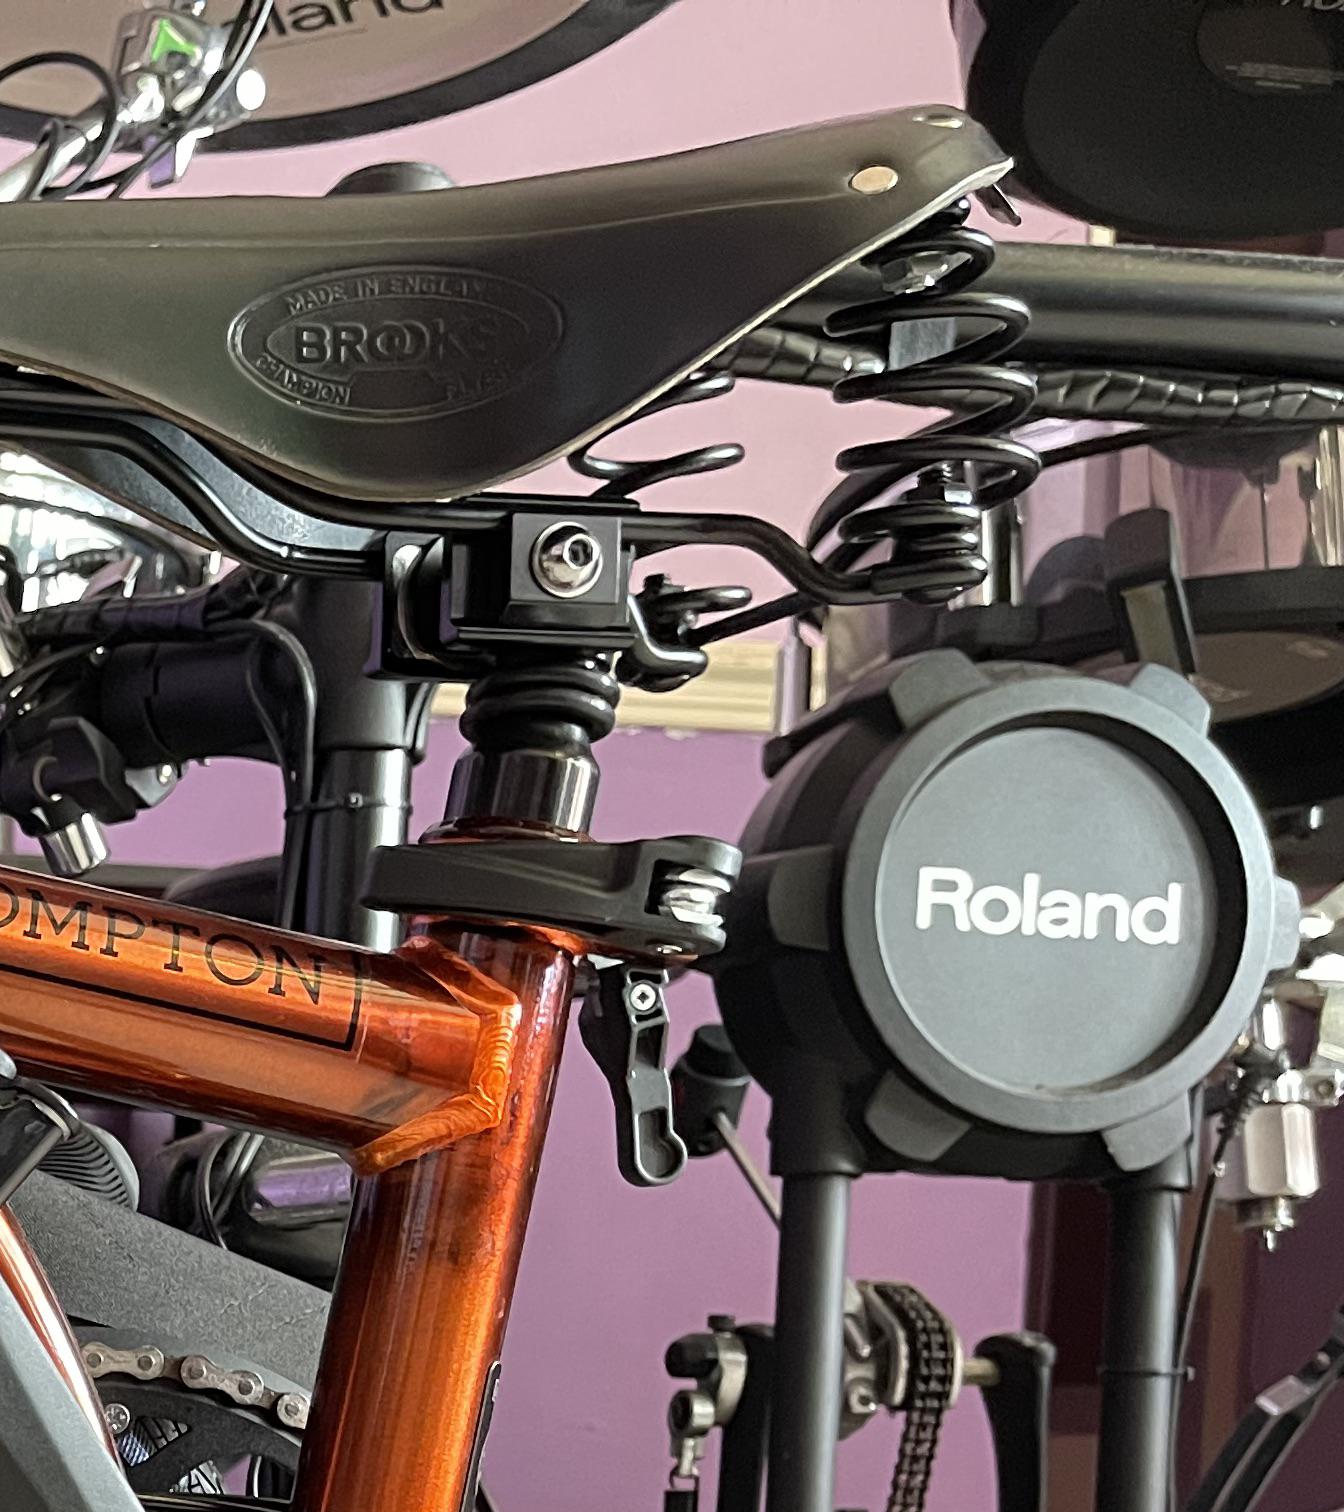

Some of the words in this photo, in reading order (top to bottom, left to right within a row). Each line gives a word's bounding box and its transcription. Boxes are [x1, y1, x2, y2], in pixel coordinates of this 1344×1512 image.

[285, 282, 348, 316] MADE
[356, 276, 380, 299] IN
[294, 318, 504, 365] BROOKS
[915, 865, 1183, 946] Roland
